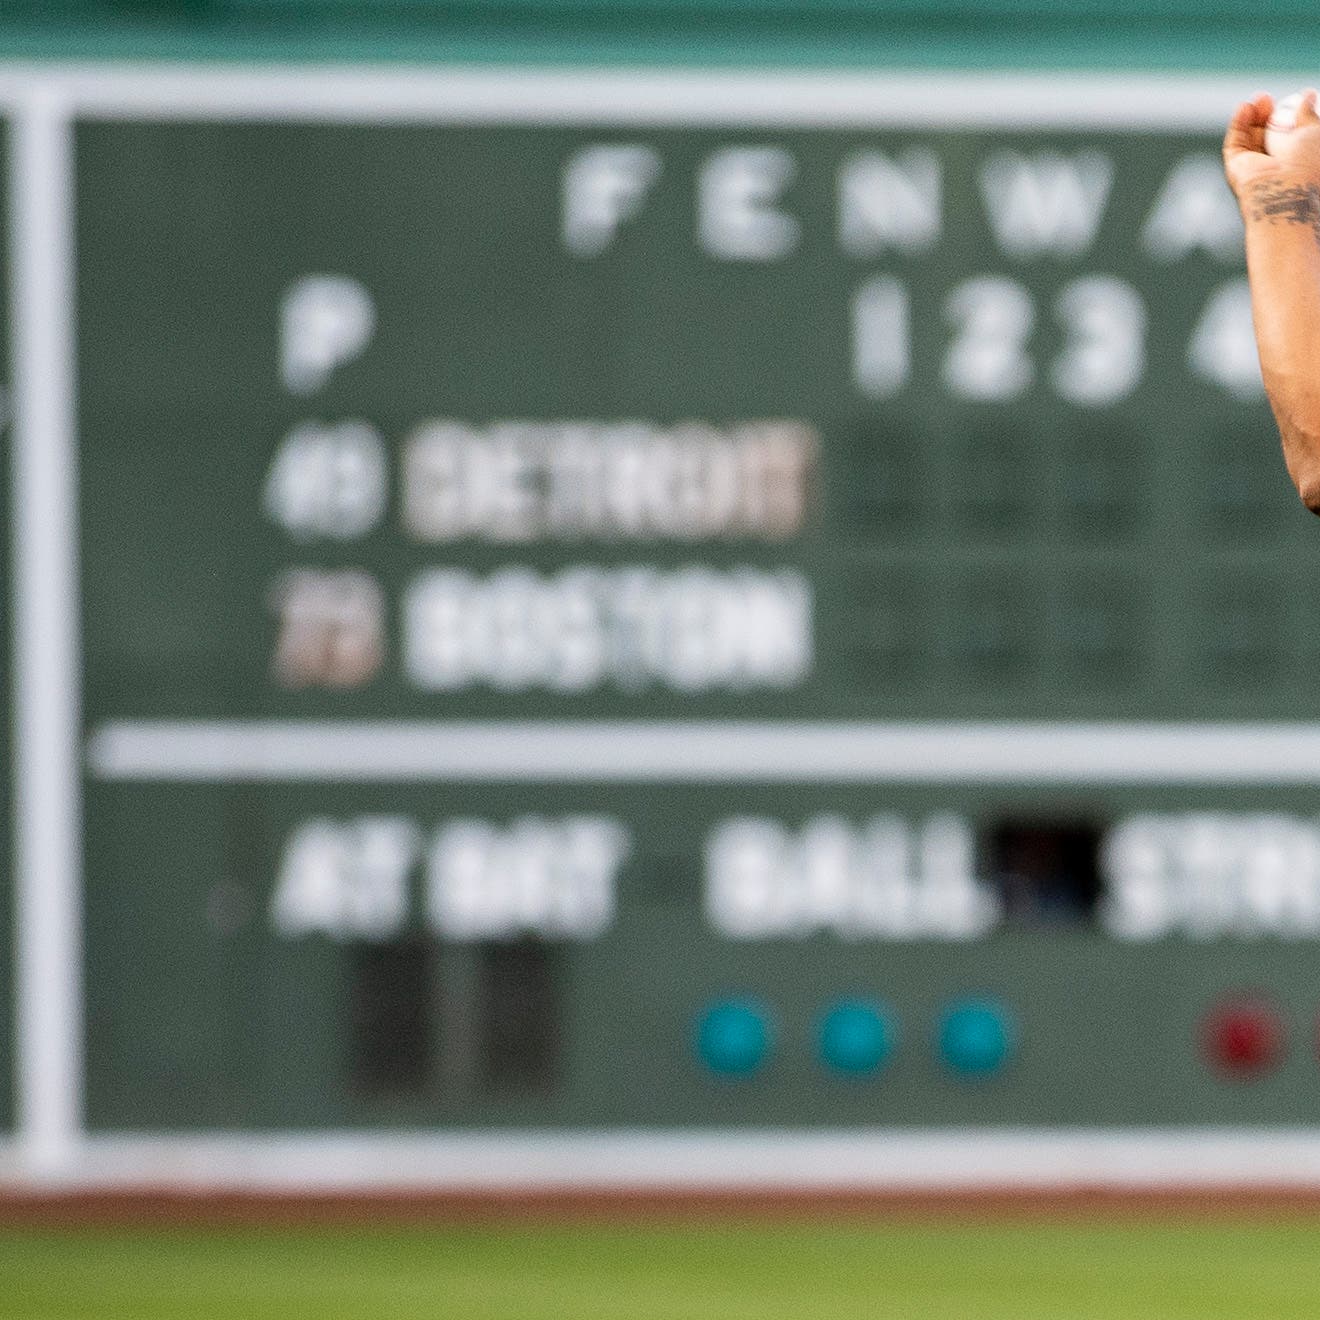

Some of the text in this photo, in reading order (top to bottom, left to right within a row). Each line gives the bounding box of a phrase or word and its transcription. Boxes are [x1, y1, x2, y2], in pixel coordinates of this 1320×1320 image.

[282, 278, 372, 387] P
[853, 279, 910, 394] 1
[945, 278, 1032, 399] 2
[1057, 278, 1143, 403] 3
[406, 423, 810, 539] DETROIT
[406, 568, 811, 689] BOSTON
[273, 817, 413, 935] AT
[428, 817, 624, 938] BAT
[706, 817, 992, 939] BALL
